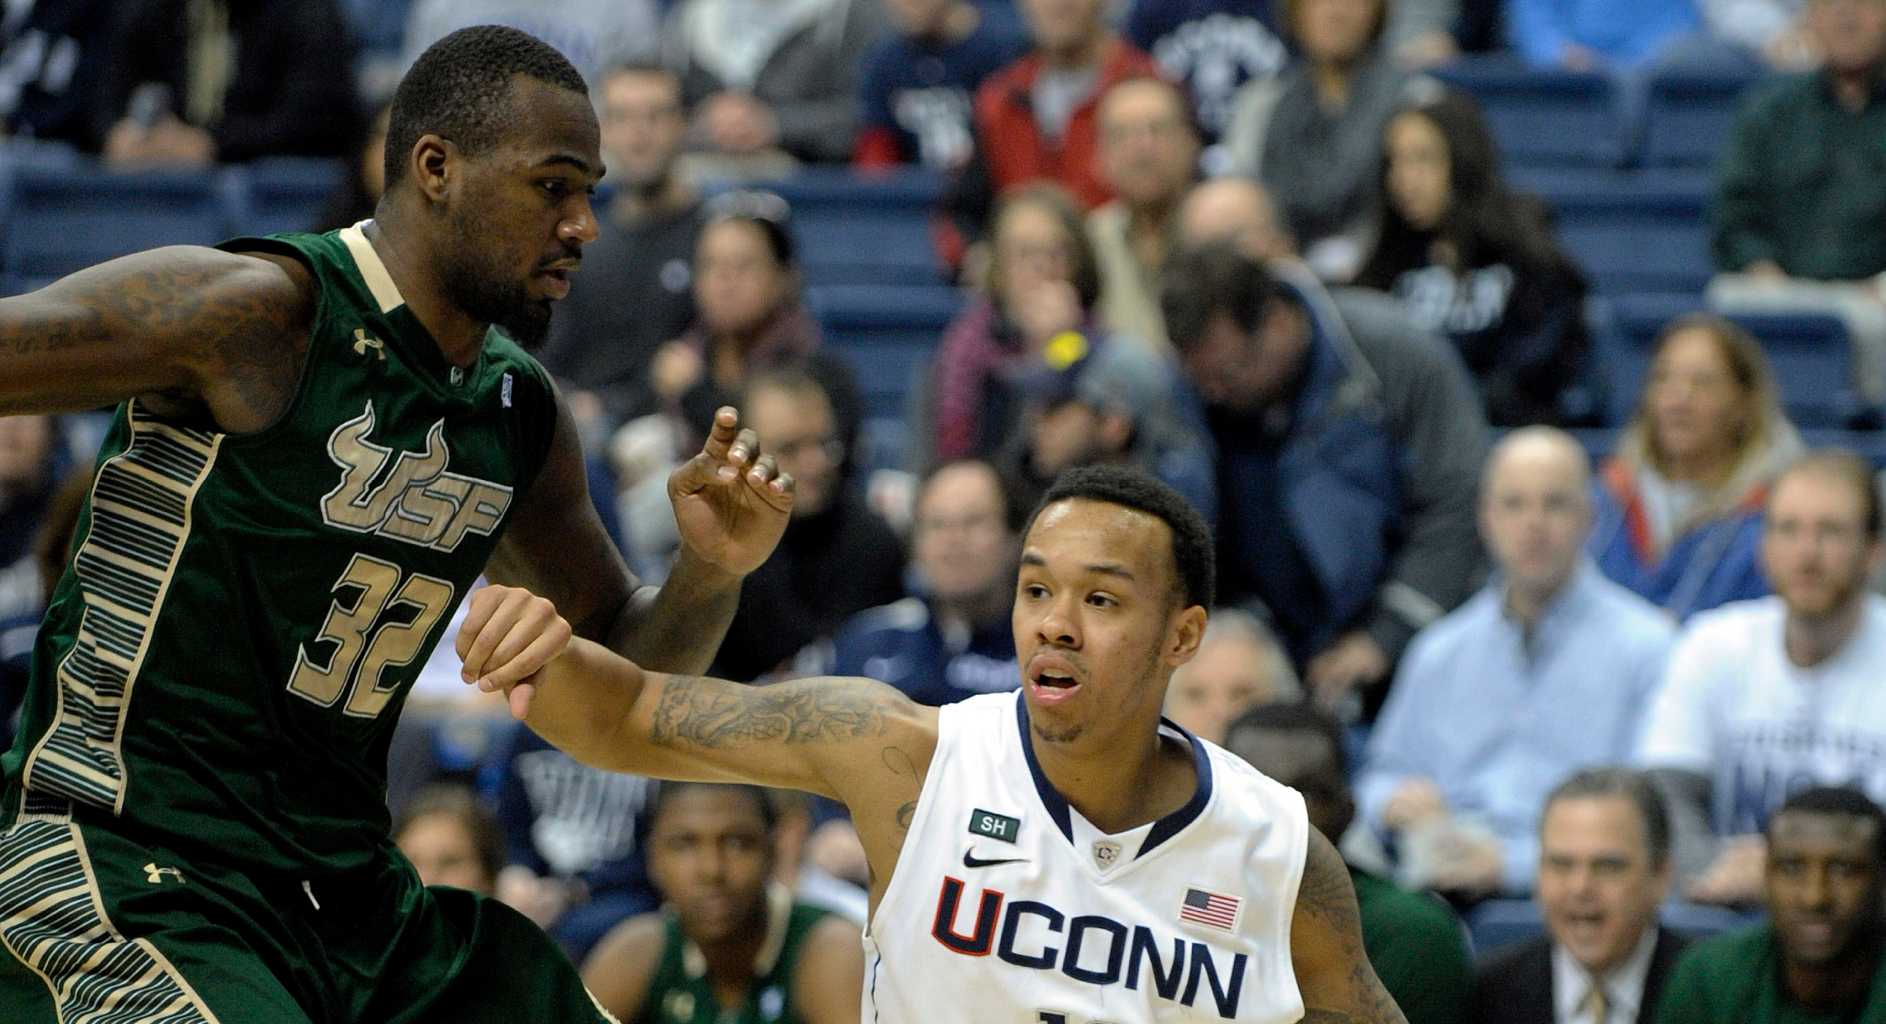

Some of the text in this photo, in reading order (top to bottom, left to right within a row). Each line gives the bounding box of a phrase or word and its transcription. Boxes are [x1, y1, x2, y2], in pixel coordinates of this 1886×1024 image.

[320, 398, 514, 553] USF
[286, 552, 455, 719] 32
[980, 816, 1007, 836] SH
[931, 875, 1249, 1020] UCONN
